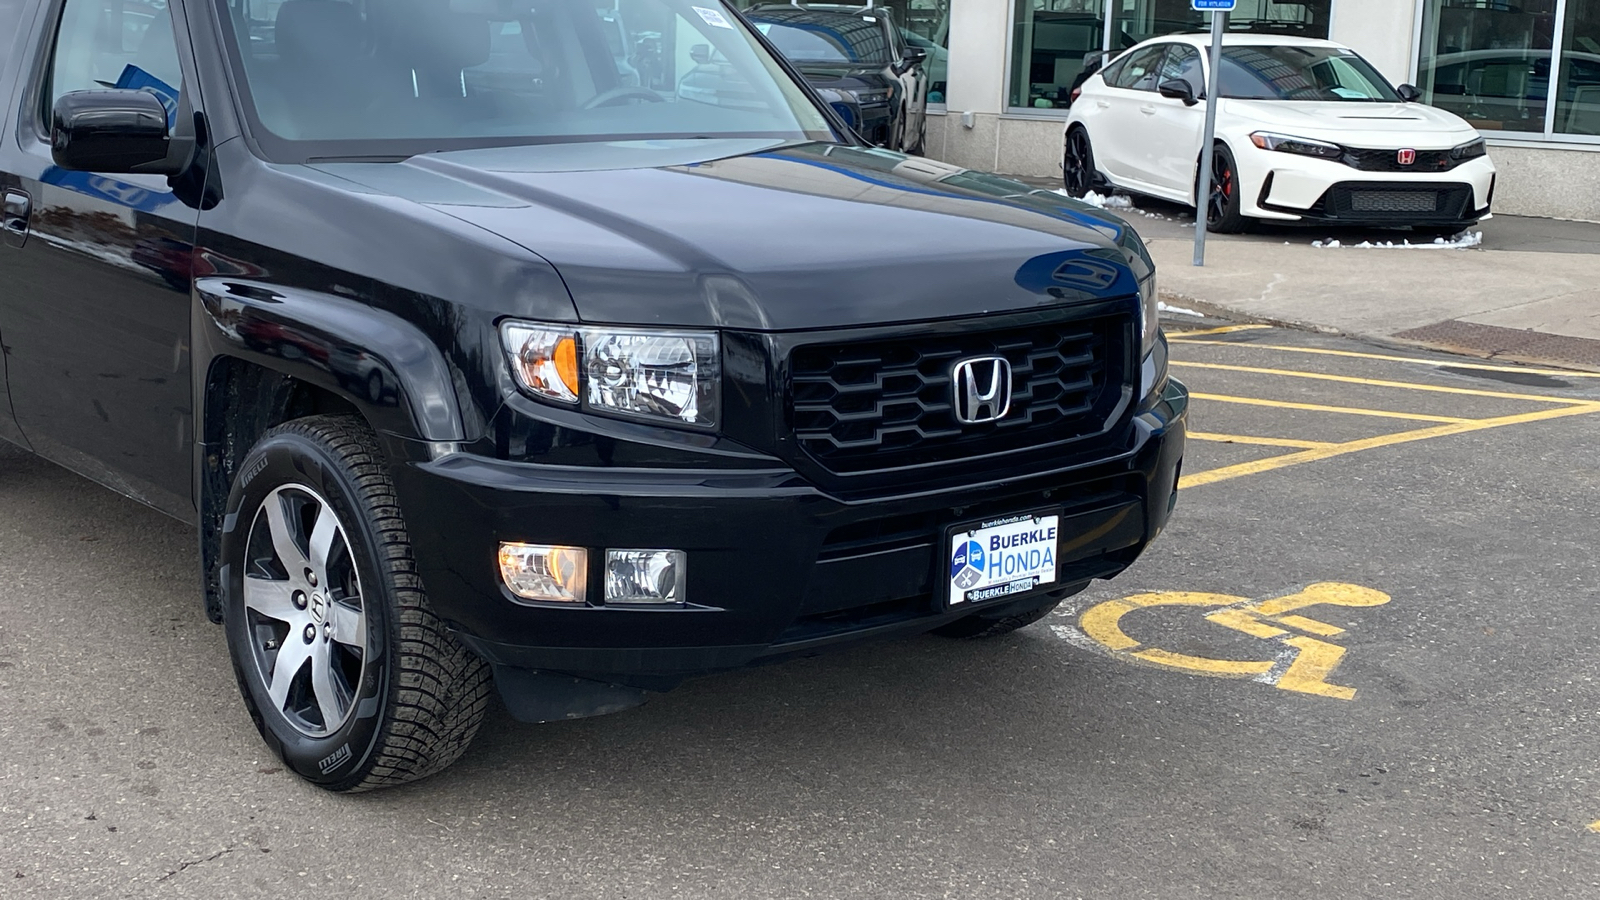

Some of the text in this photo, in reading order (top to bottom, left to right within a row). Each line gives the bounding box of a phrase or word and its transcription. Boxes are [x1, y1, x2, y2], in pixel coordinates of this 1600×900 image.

[240, 452, 269, 489] PIRELLI
[981, 514, 1032, 529] buerklehonda.com
[990, 527, 1056, 551] BUERKLE
[989, 547, 1054, 579] HONDA
[973, 585, 1010, 600] BUERKLE
[318, 742, 353, 775] PIRELLI
